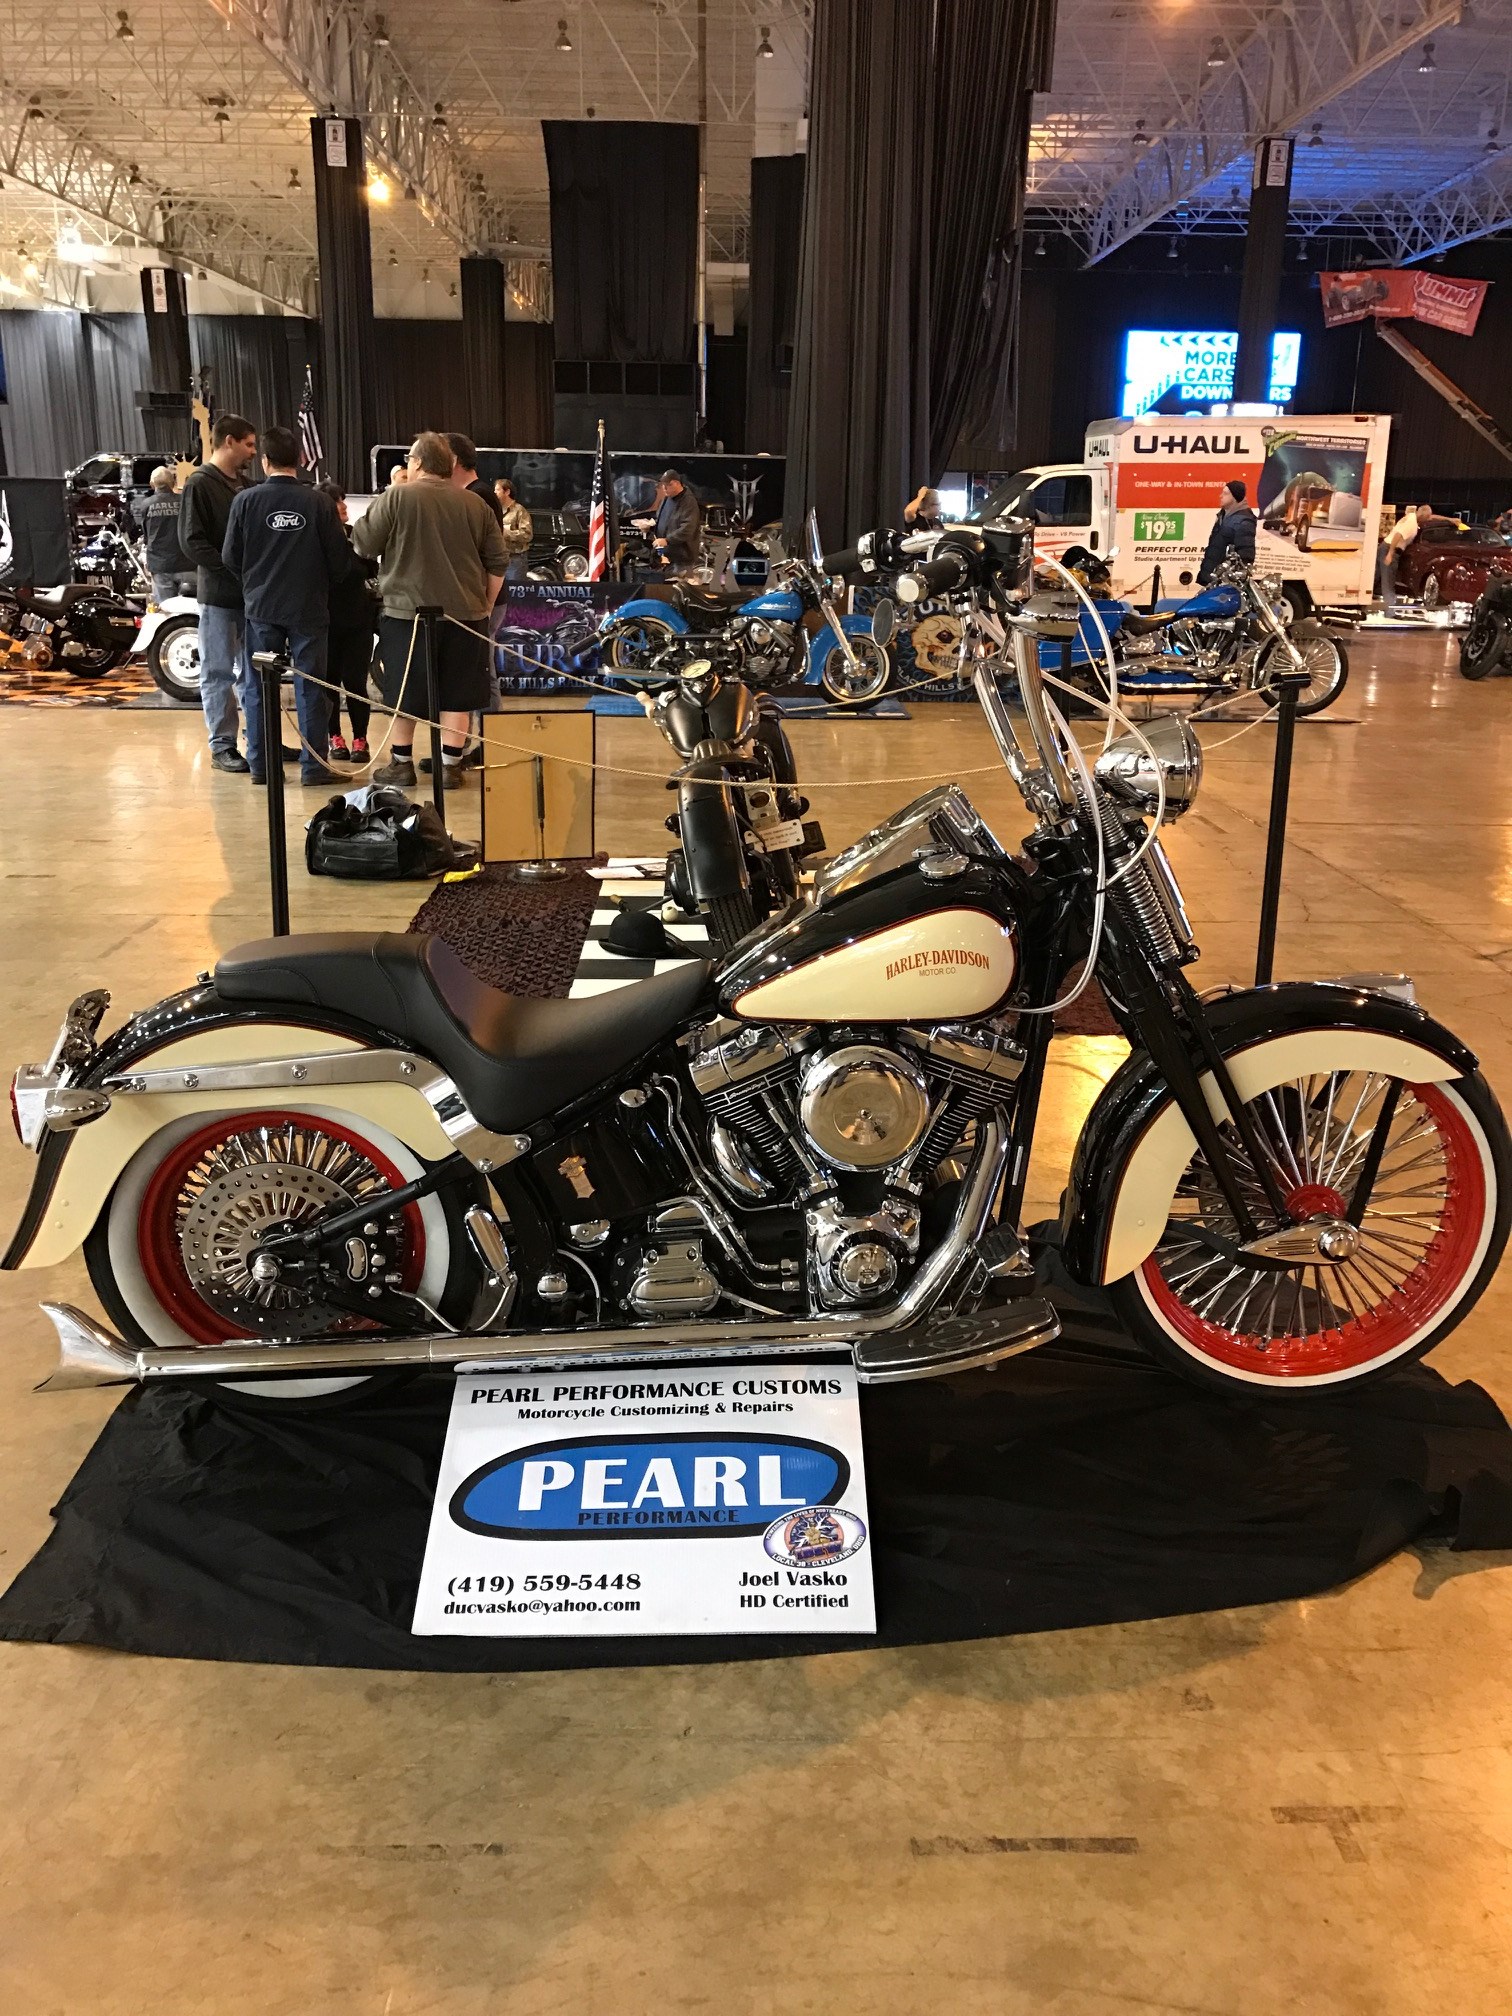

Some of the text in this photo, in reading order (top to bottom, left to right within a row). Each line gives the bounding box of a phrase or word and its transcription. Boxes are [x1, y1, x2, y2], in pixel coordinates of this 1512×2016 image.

[1185, 350, 1237, 366] MORE
[1184, 367, 1234, 382] CARS
[1133, 435, 1250, 454] U-HAUL
[147, 508, 179, 517] DAVIDS
[149, 501, 180, 510] HARLE
[271, 514, 300, 530] Ford
[508, 585, 594, 598] 73rd ANNUAL
[518, 676, 555, 690] HILLS
[924, 682, 955, 692] HILLS
[886, 949, 990, 980] HARLEY-DAVIDSON
[918, 967, 957, 977] MOTOR CO
[471, 1379, 842, 1404] PEARL PERFORMANCE CUSTOMS
[517, 1401, 794, 1420] Motorcycle Customizing & Repairs
[517, 1454, 807, 1511] PEARL
[577, 1509, 740, 1526] PERFORMANCE
[772, 1553, 795, 1567] LOCAL
[853, 1535, 865, 1550] OHIO
[447, 1573, 641, 1596] (419) 559-5448
[738, 1571, 847, 1587] Joel Vasko
[444, 1599, 641, 1615] ducvasko@yahoo.com
[740, 1593, 849, 1609] HD Certified
